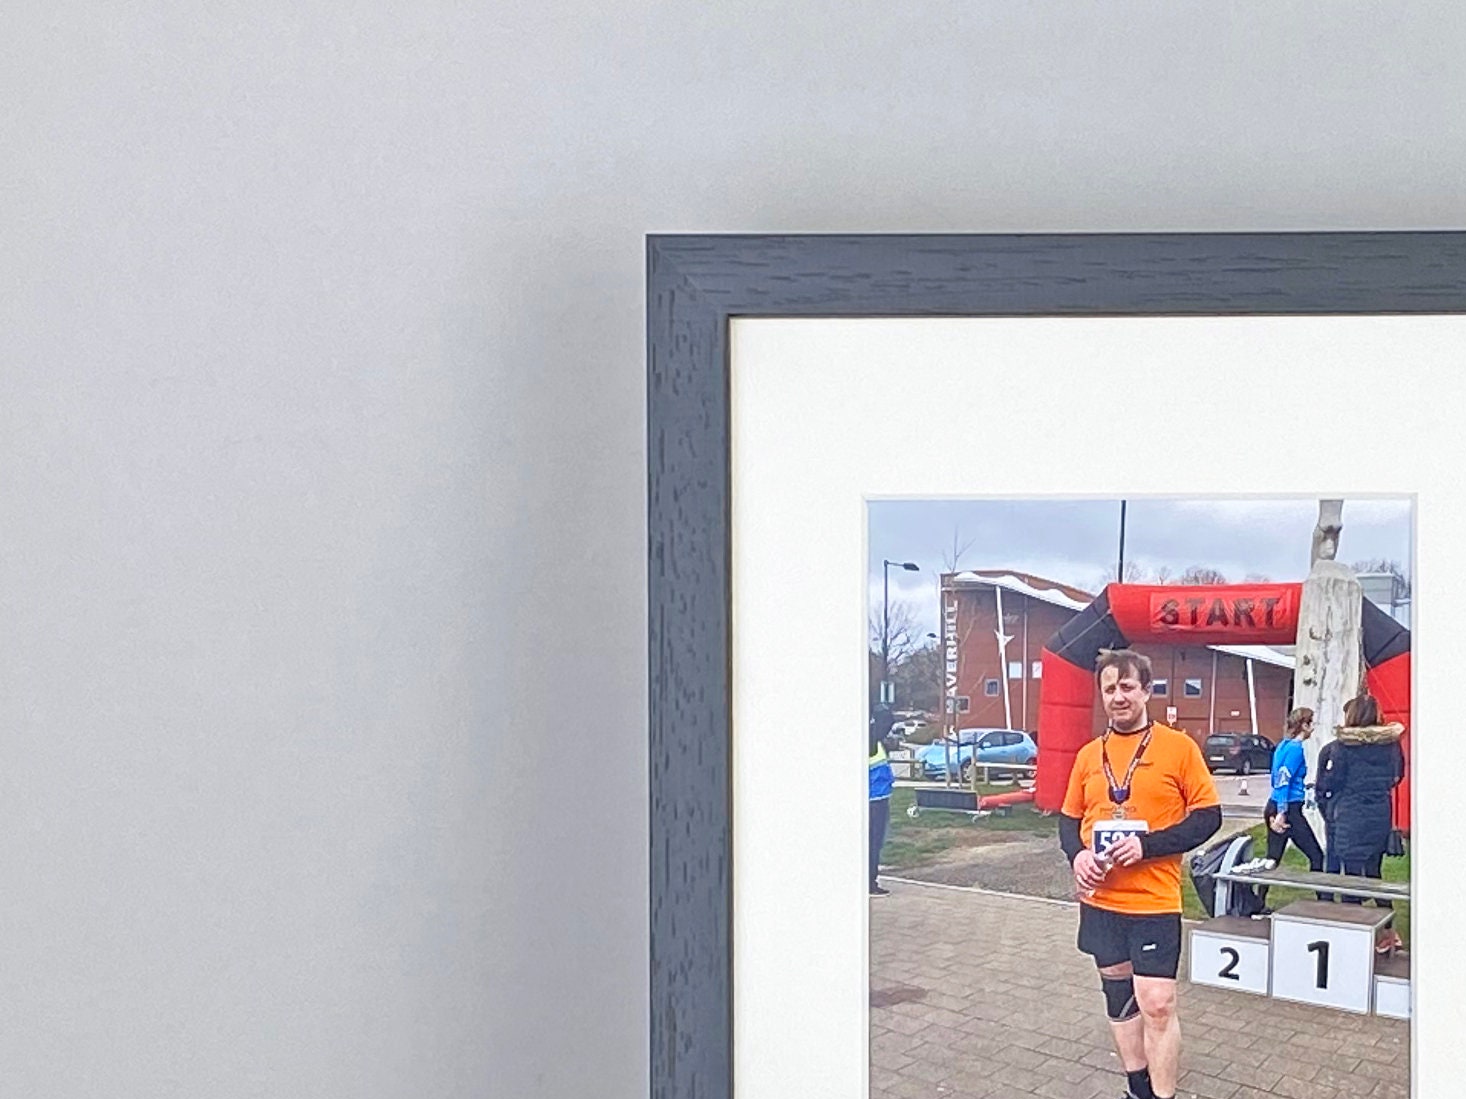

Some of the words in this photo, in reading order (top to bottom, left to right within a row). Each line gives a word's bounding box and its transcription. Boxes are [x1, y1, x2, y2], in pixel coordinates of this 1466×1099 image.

[1159, 597, 1281, 627] START
[1218, 946, 1240, 981] 2
[1306, 940, 1330, 990] 1
